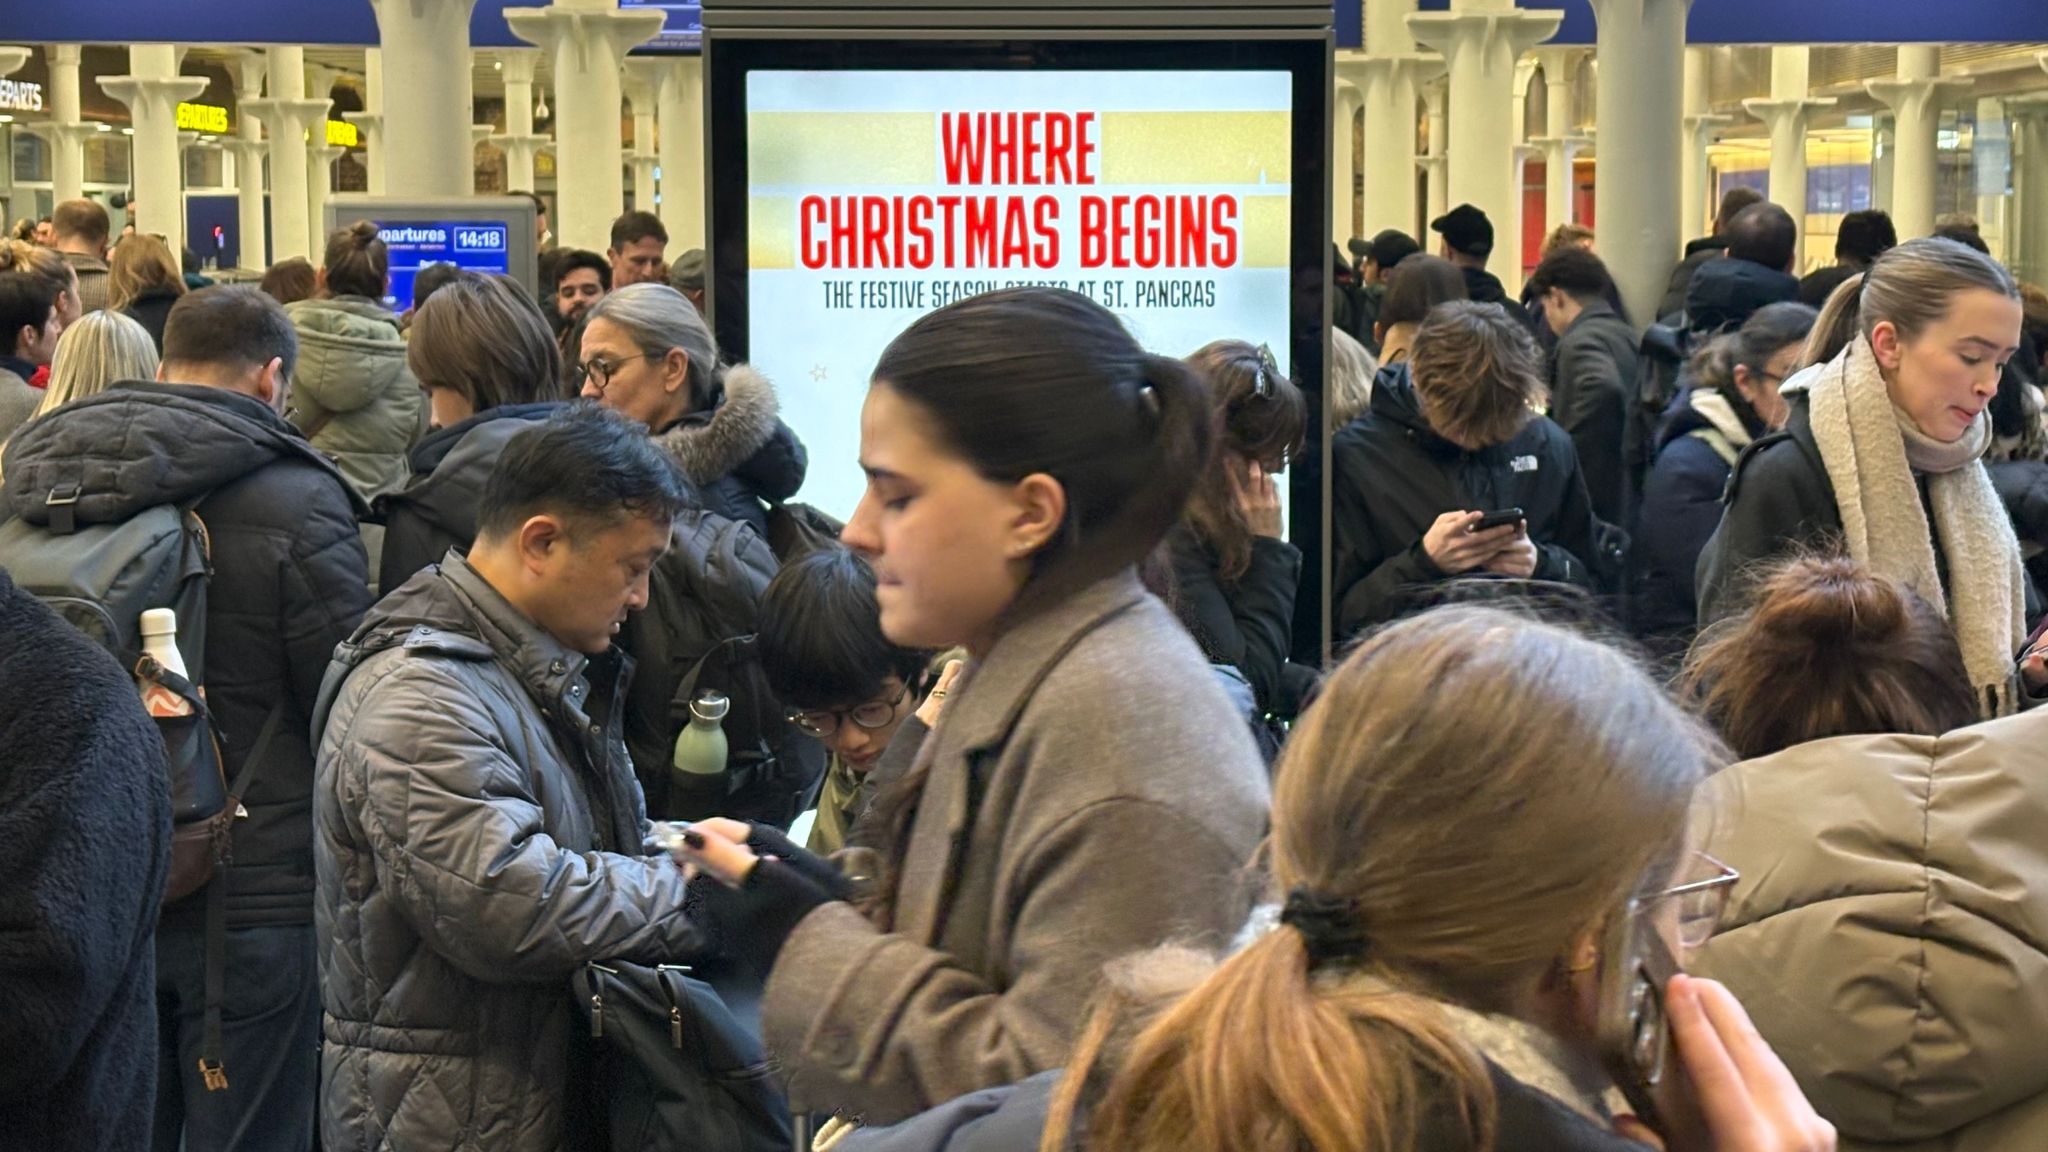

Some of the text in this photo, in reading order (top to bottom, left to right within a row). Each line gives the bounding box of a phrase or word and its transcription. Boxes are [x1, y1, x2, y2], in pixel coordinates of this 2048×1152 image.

[0, 80, 42, 111] EPARTS
[941, 111, 1095, 186] WHERE
[459, 230, 501, 248] 14:18
[800, 194, 1238, 270] CHRISTMAS BEGINS
[823, 280, 854, 309] THE
[860, 280, 925, 309] FESTIVE
[1103, 280, 1129, 308] ST.
[1135, 280, 1216, 308] PANCRAS
